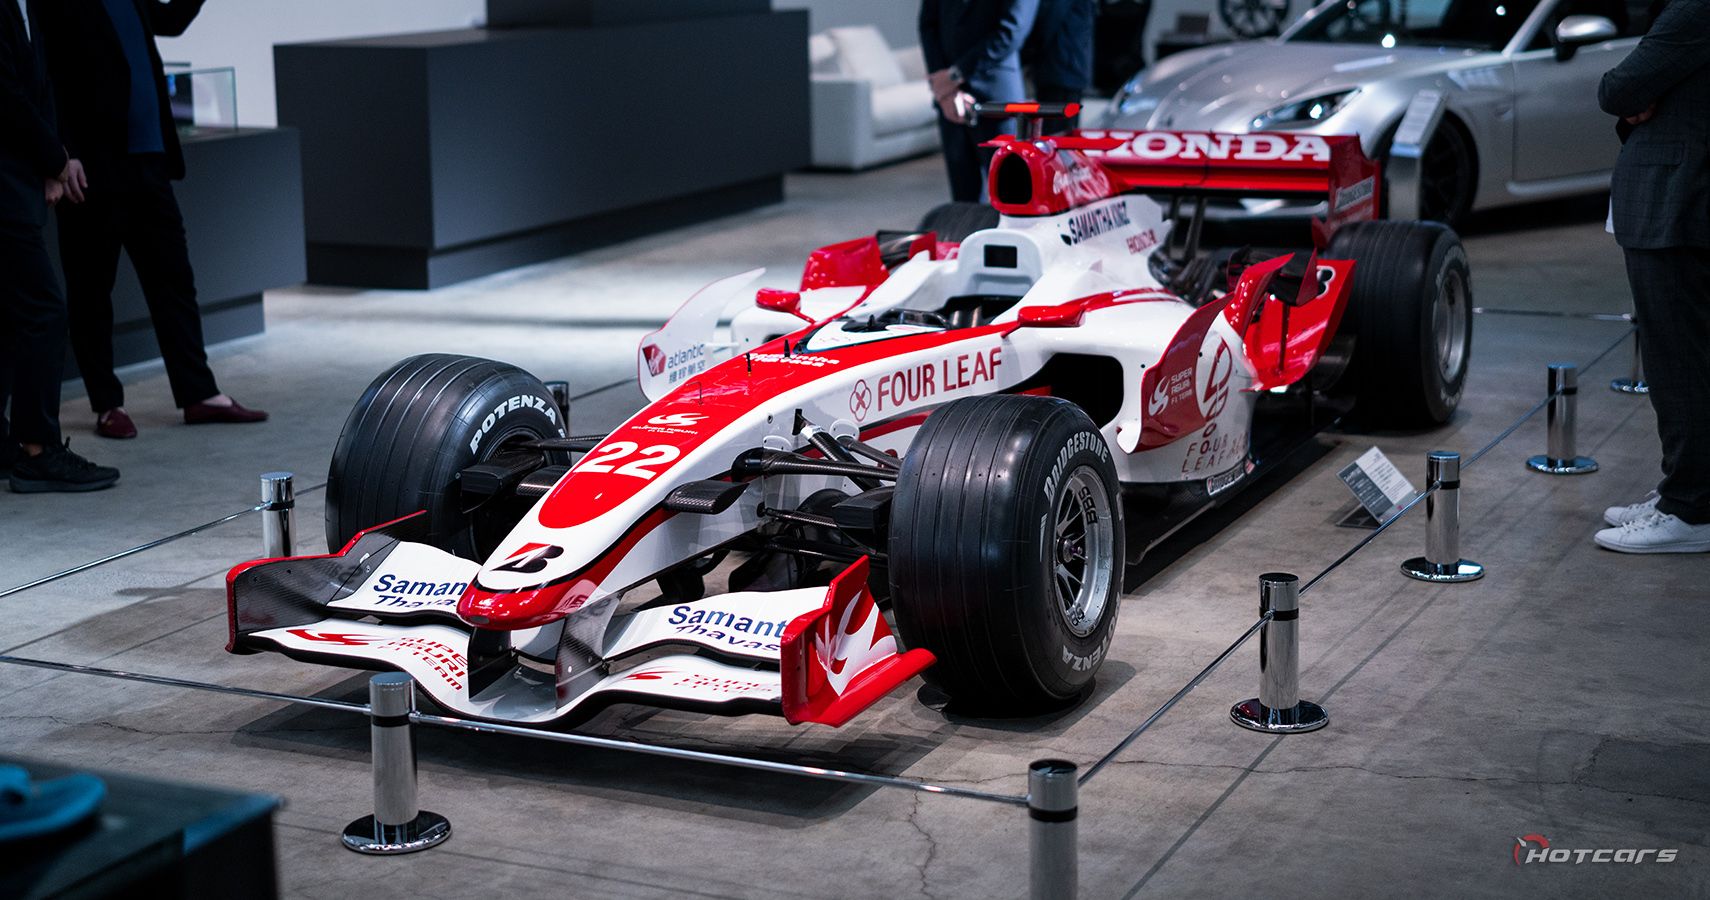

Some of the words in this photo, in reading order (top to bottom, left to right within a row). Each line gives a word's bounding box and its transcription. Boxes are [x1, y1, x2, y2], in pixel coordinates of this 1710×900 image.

[668, 344, 705, 369] atlantic
[877, 363, 935, 412] FOUR
[943, 347, 1002, 392] LEAF
[469, 394, 557, 455] POTENZA
[572, 441, 681, 480] 22
[1043, 431, 1108, 508] BRIDGESTONE
[1079, 486, 1098, 525] BBS
[373, 594, 460, 608] Thava
